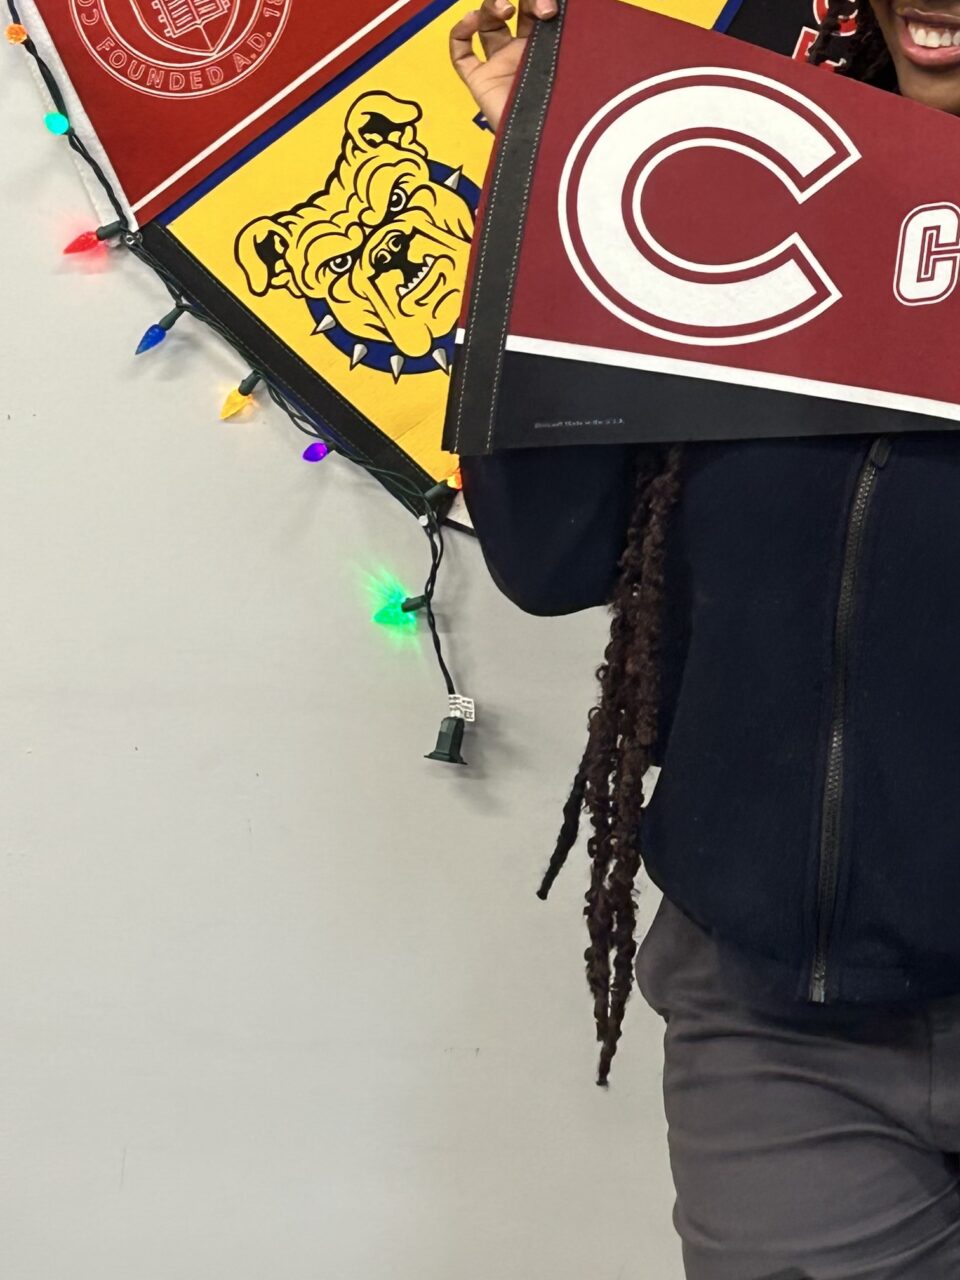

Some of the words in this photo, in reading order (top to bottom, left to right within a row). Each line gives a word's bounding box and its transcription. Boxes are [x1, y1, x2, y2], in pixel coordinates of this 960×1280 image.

[96, 36, 224, 90] FOUNDED
[233, 31, 272, 72] A.D.
[558, 66, 862, 346] C
